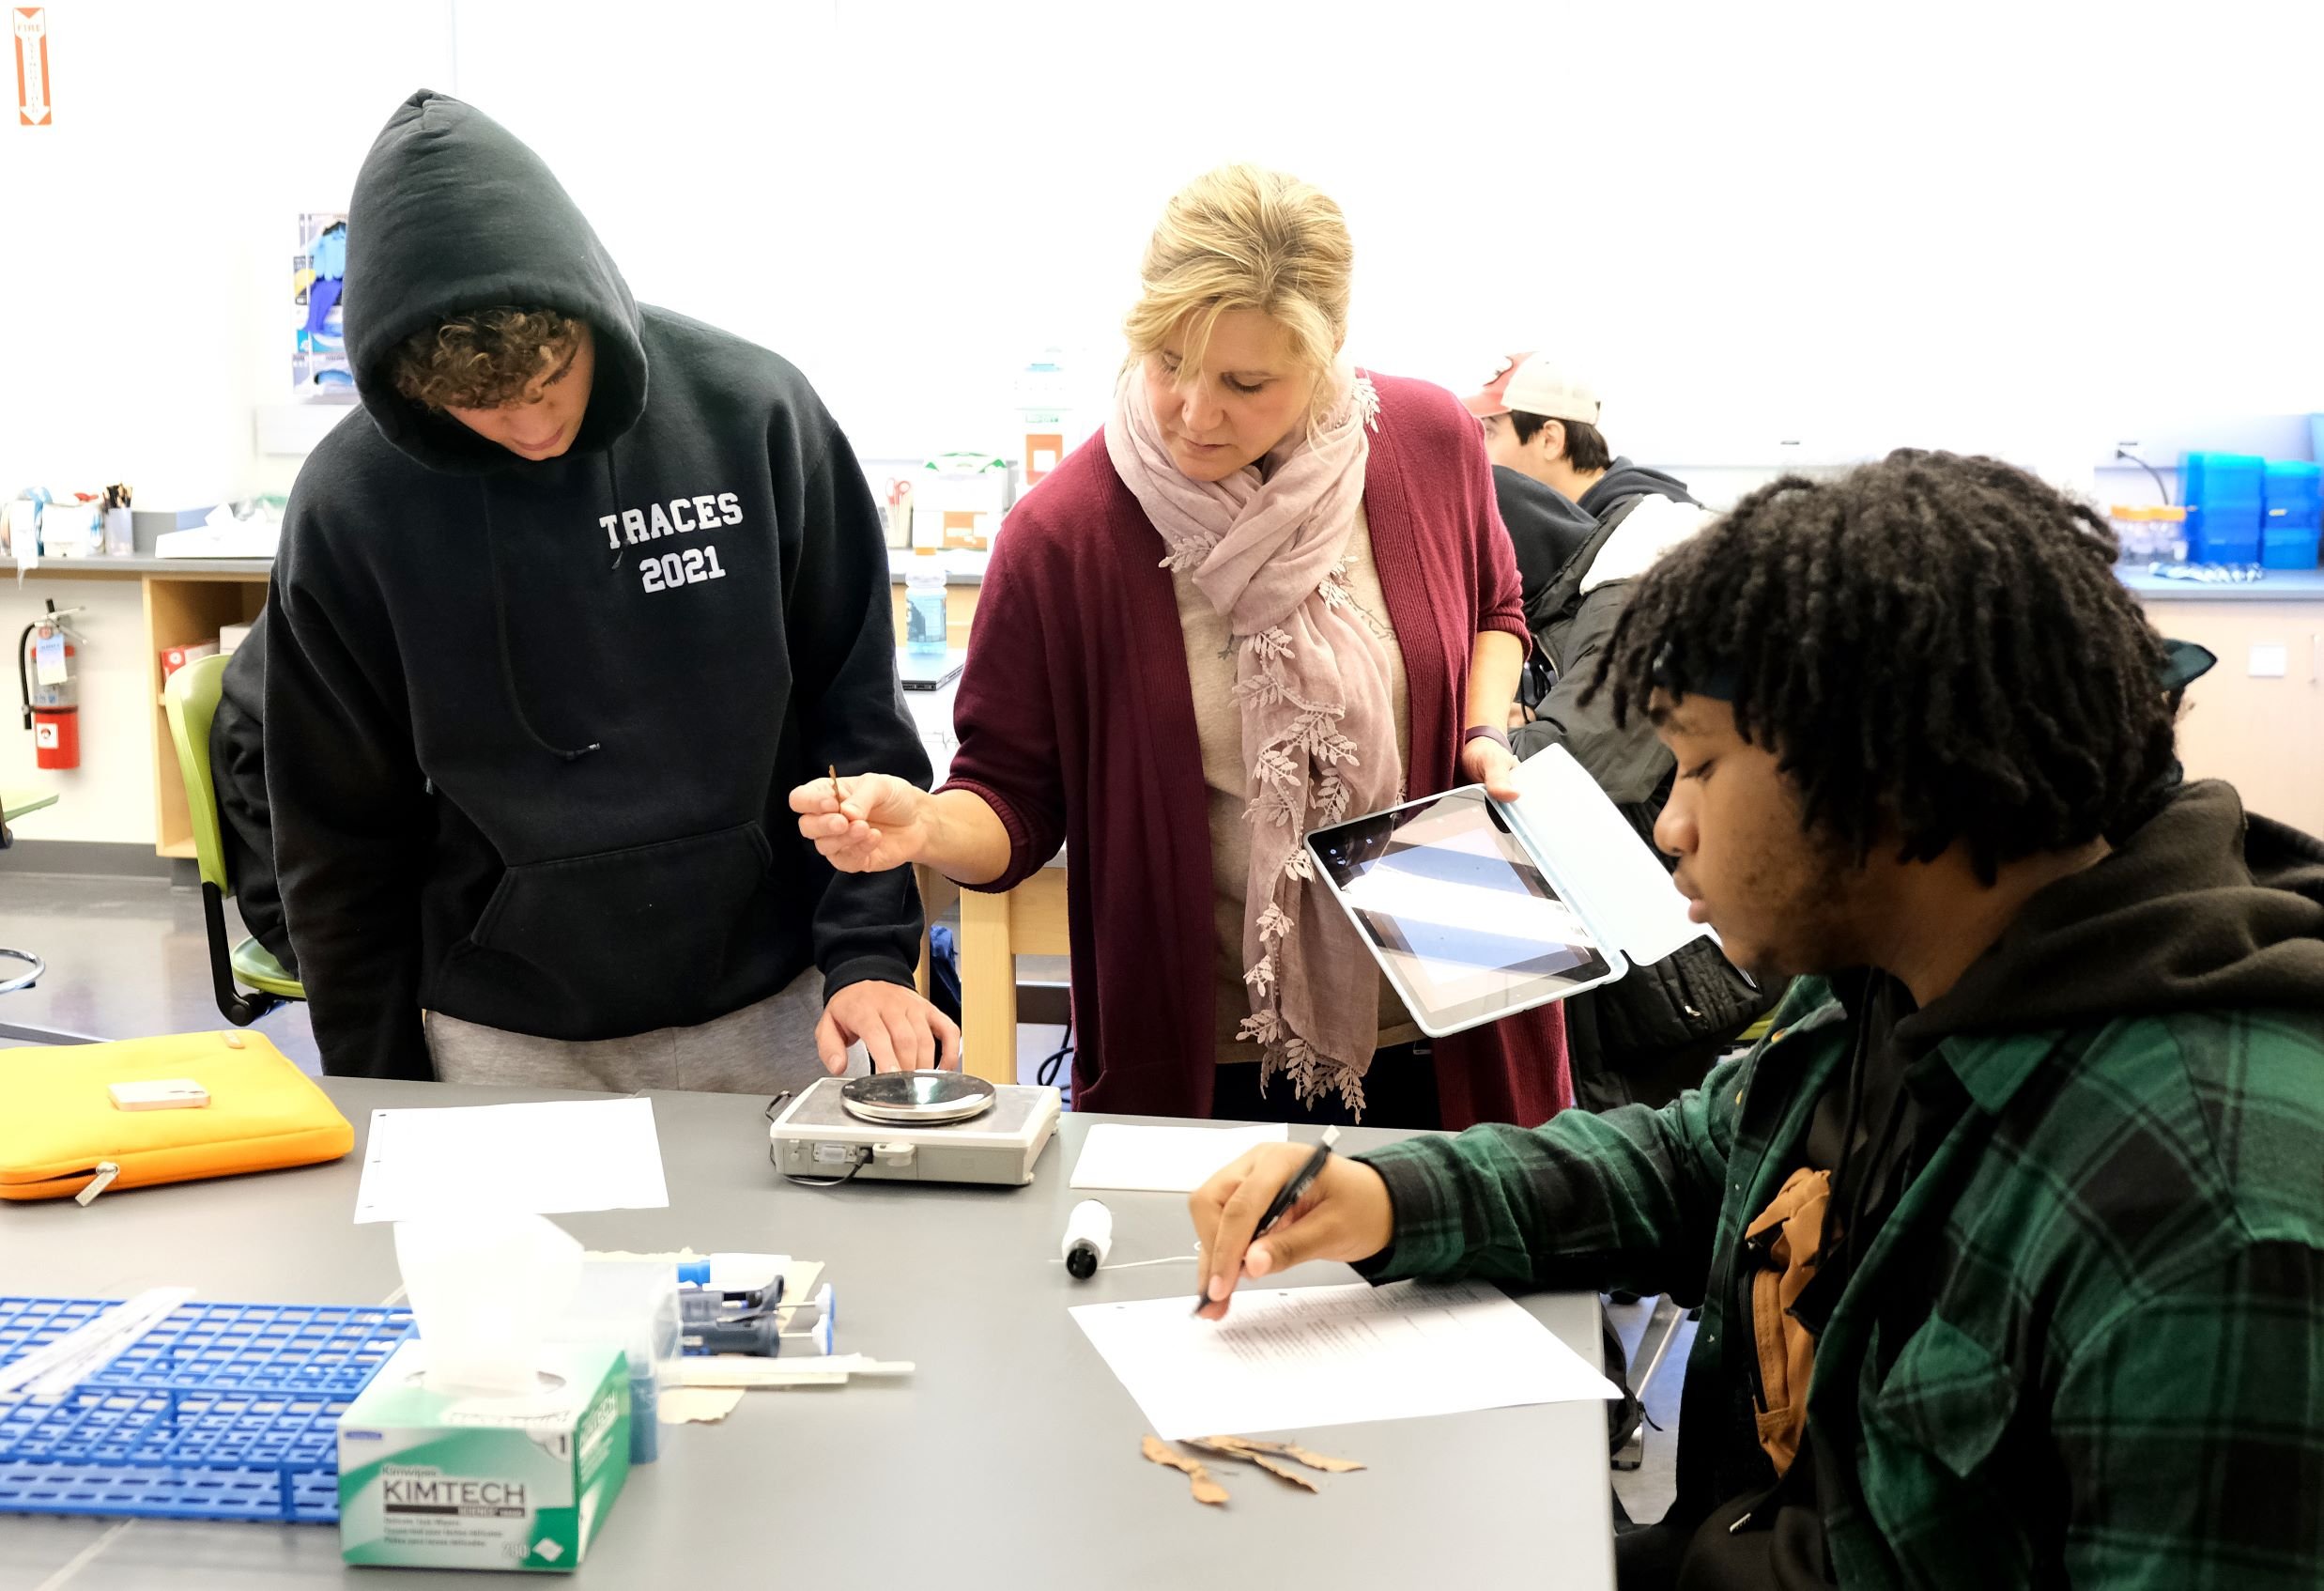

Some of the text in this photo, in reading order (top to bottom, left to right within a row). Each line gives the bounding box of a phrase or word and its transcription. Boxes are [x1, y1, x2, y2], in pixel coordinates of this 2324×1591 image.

[599, 492, 744, 549] TRACES
[639, 546, 726, 594] 2021
[383, 1479, 525, 1504] KIMTECH
